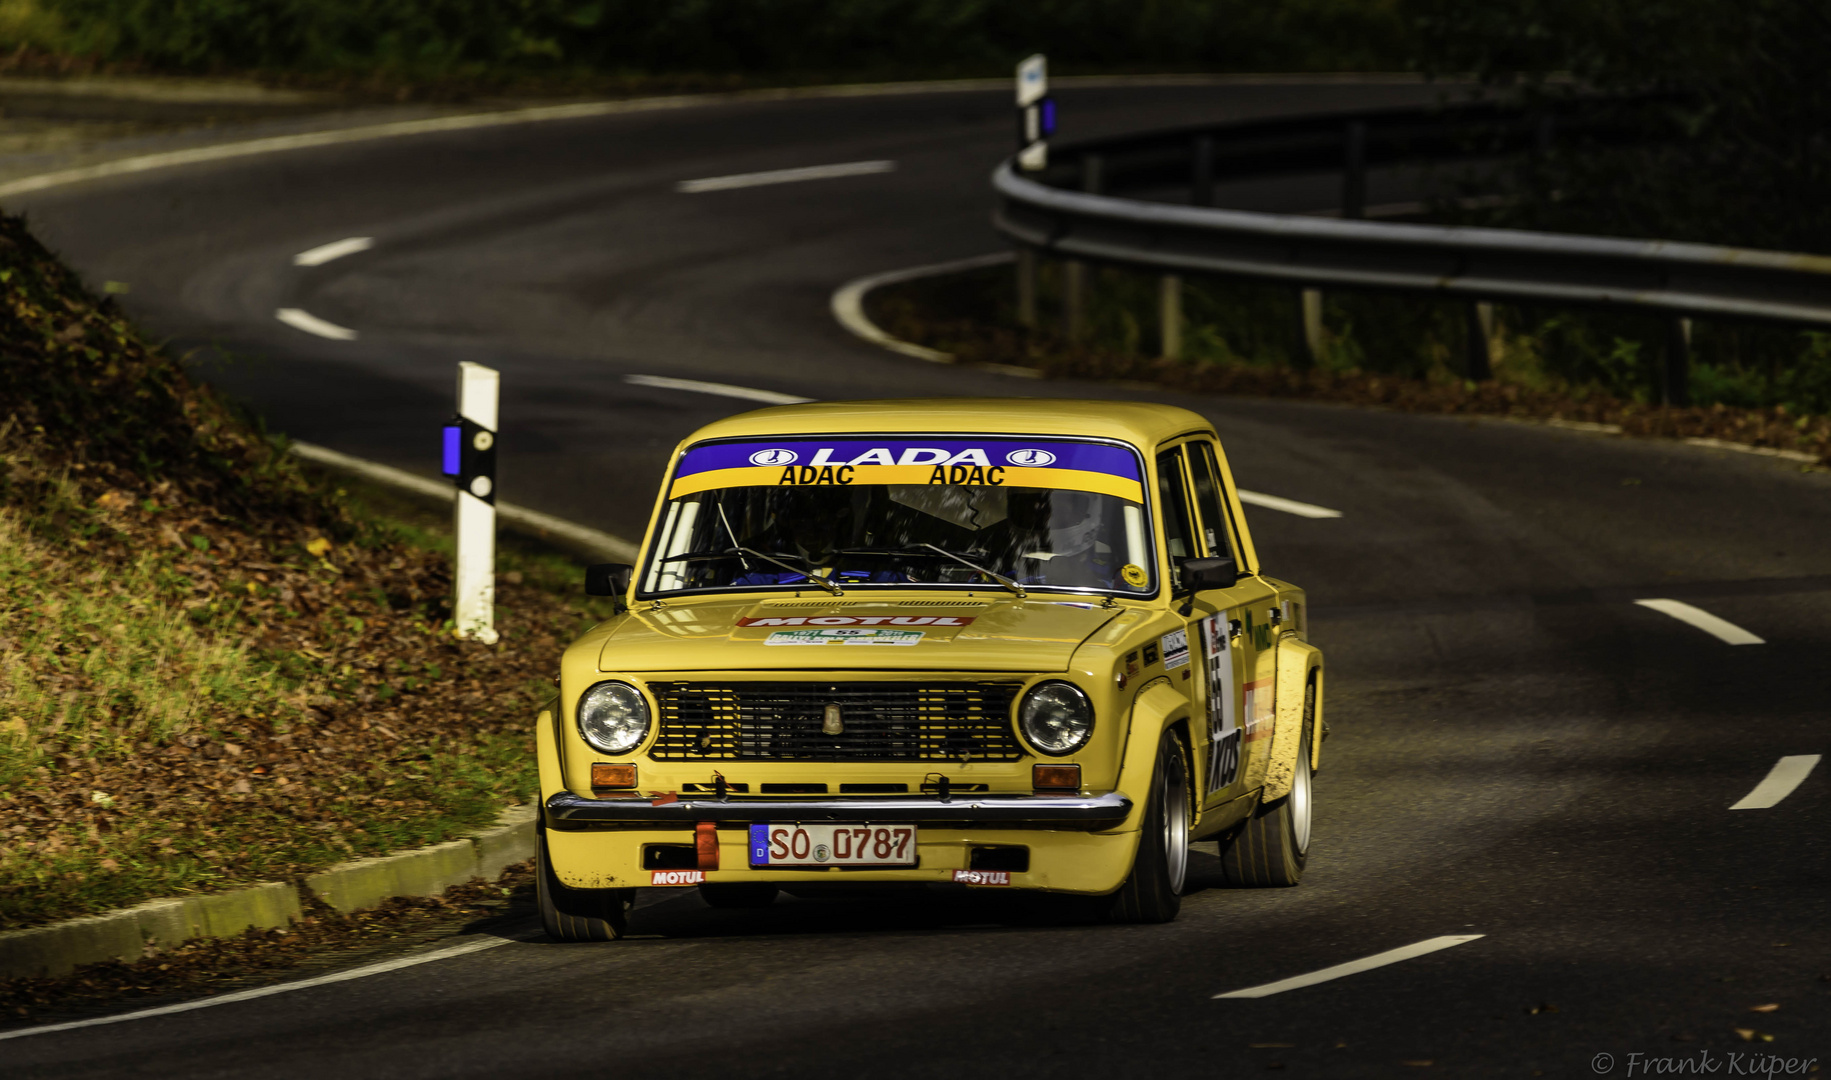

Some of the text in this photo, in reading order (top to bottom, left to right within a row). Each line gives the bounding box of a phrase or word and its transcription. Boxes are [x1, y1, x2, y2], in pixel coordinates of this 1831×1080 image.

[808, 448, 991, 466] LADA
[779, 466, 855, 485] ADAC
[929, 466, 1005, 485] ADAC
[747, 616, 964, 627] MOTUL
[770, 828, 912, 860] SO 0787
[756, 848, 764, 857] D
[652, 871, 704, 884] MOTUL
[954, 870, 1009, 884] MOTUL
